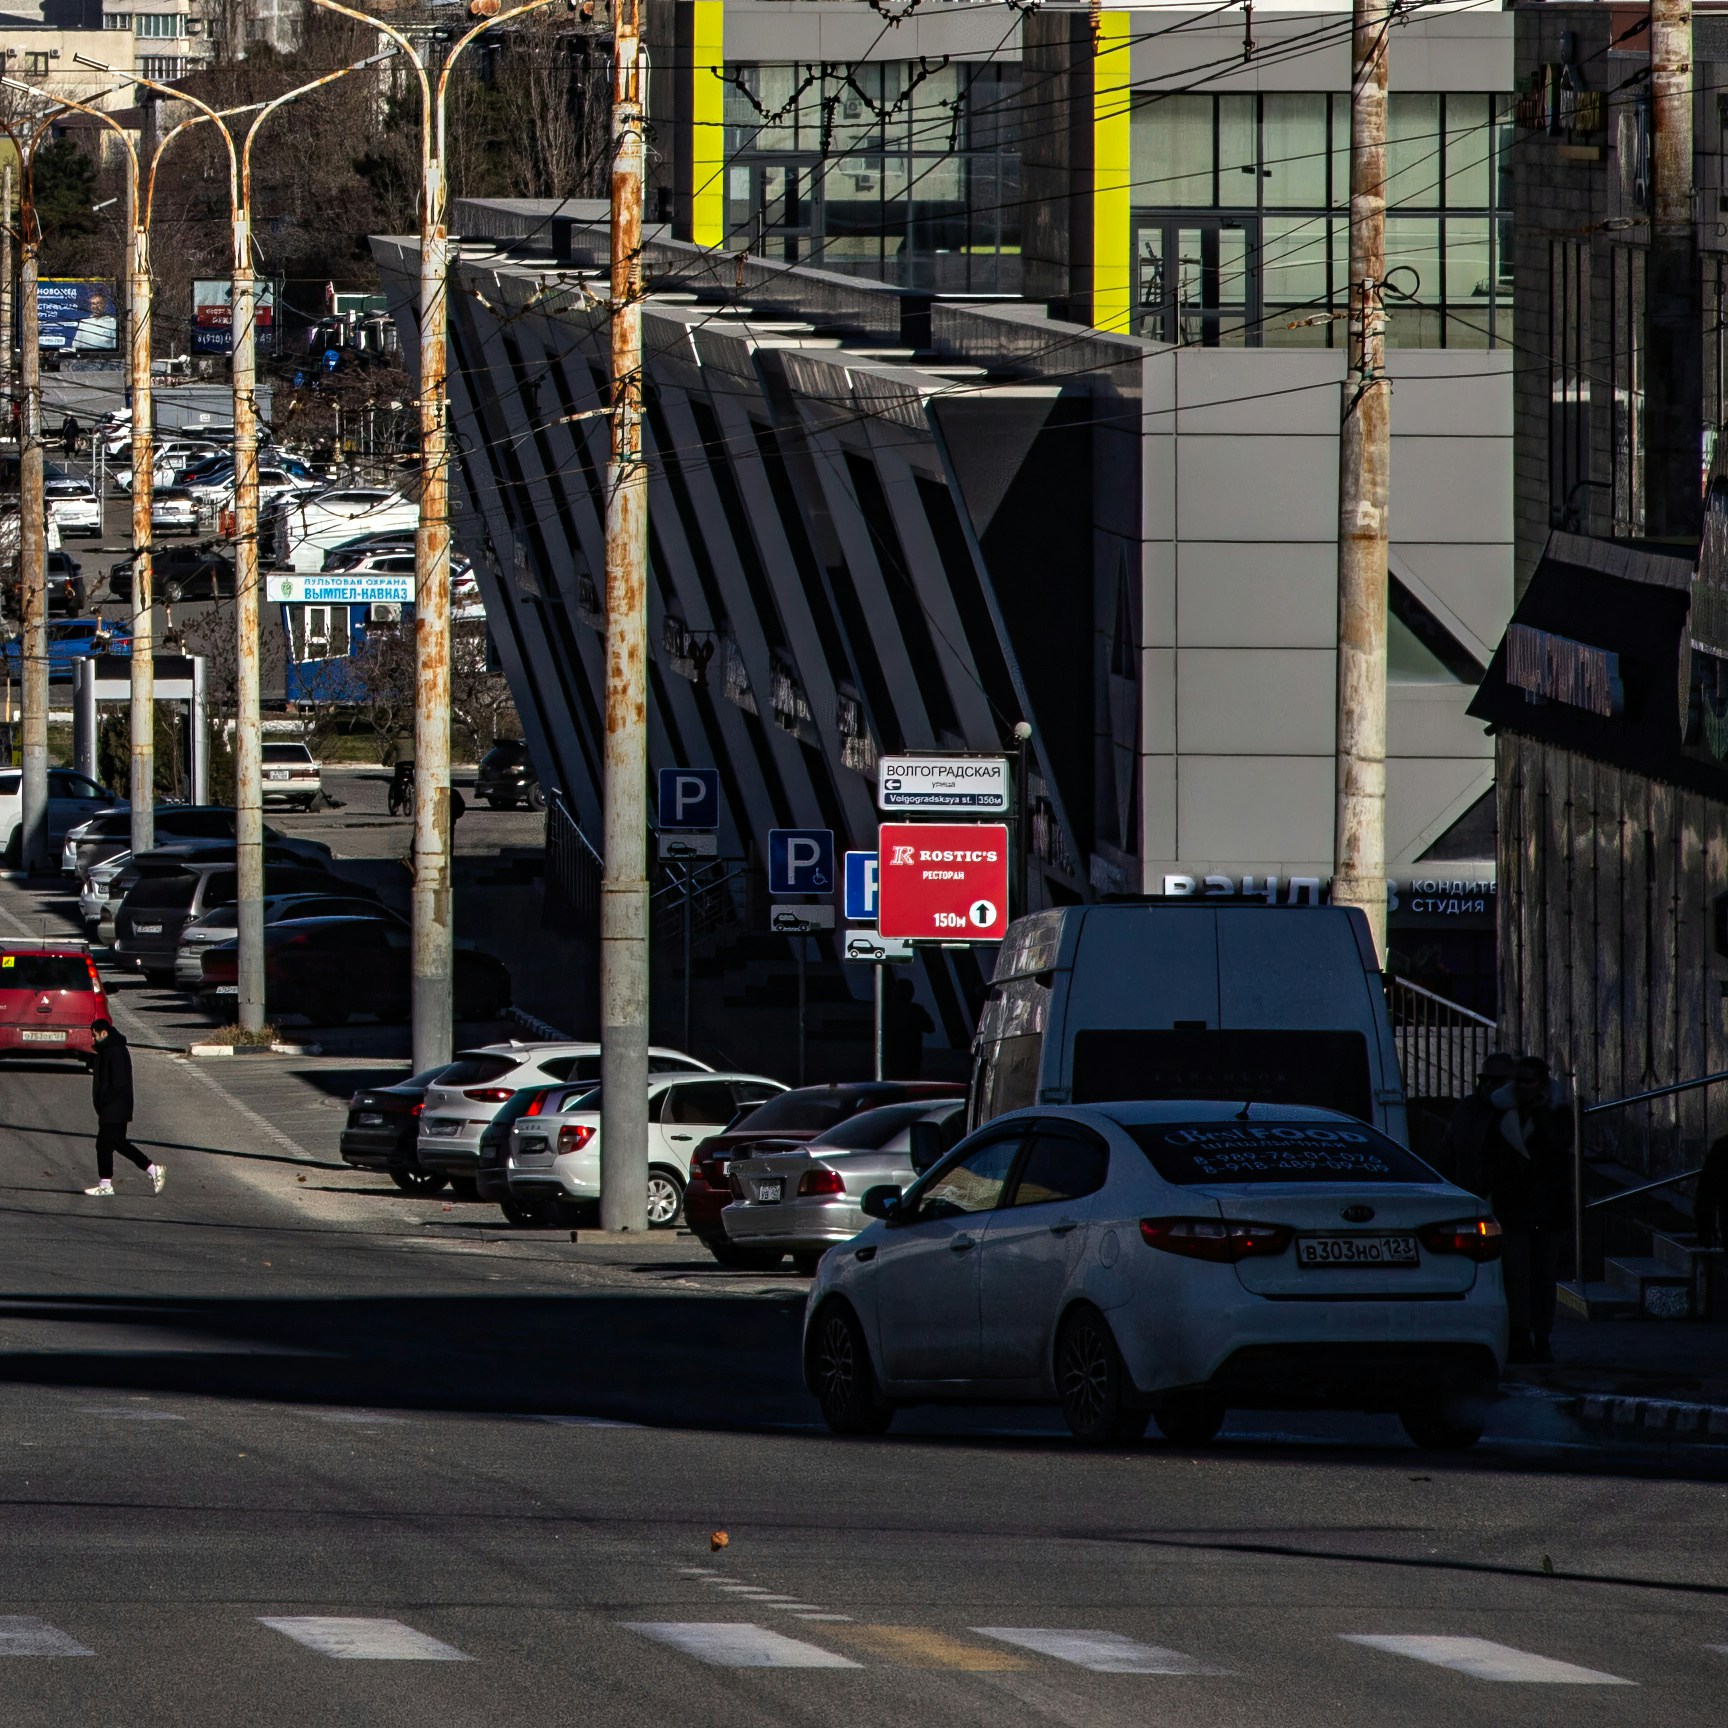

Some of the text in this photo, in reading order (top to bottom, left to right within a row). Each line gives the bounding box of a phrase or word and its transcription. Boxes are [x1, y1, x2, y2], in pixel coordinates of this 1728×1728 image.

[304, 578, 407, 586] ПУЛЬТОВАЯ ОХРАНА
[304, 587, 408, 600] ВЫМПЕЛ-КАВКАЗ
[887, 765, 1001, 779] ВОЛГОГРАДСКАЯ
[676, 776, 707, 820] P
[890, 794, 1002, 805] Volgogradskaya st. 350м
[787, 837, 821, 885] P
[920, 850, 998, 862] ROSTIC'S
[922, 870, 965, 880] РЕСТОРАН
[1412, 899, 1485, 915] СТУДИЯ
[933, 912, 966, 928] 150м
[1305, 1238, 1411, 1261] В303НО 123
